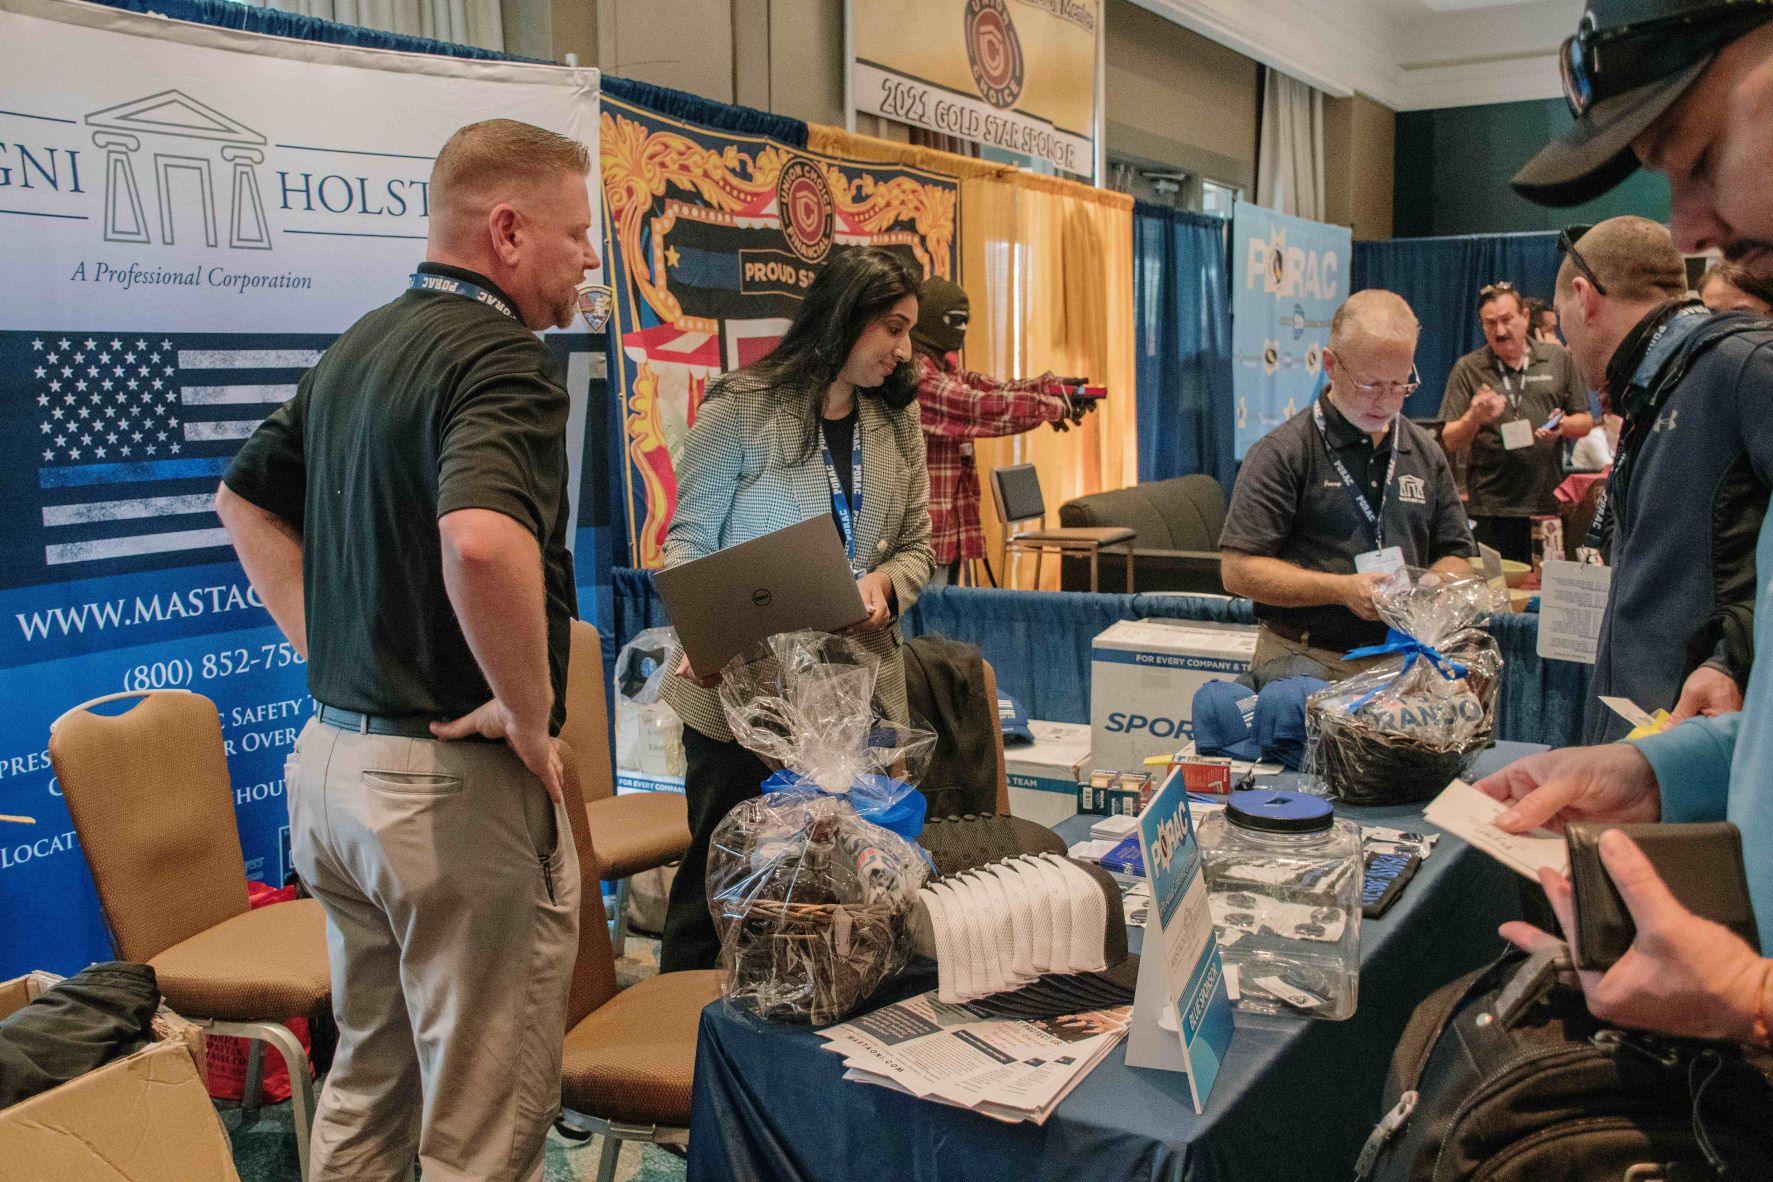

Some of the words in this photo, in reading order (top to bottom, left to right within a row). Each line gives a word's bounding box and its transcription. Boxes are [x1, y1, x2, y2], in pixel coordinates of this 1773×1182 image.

[880, 78, 932, 127] 2021
[935, 99, 980, 137] GOLD
[984, 114, 1020, 150] STAR
[781, 164, 803, 203] UNION
[803, 165, 831, 213] CHOICE
[786, 225, 829, 258] FINANCIAL
[70, 263, 87, 282] A
[94, 263, 201, 290] Professional
[208, 269, 312, 293] Corporation
[422, 276, 459, 293] PORAC
[745, 262, 797, 284] PROUD
[826, 464, 842, 495] PORAC
[853, 464, 862, 495] PORAC
[839, 508, 852, 541] PORAC
[124, 659, 193, 691] (800)
[1136, 654, 1154, 663] FOR
[1156, 656, 1184, 665] EVERY
[1187, 659, 1230, 670] COMPANY
[232, 699, 302, 728] SAFETY
[242, 727, 297, 753] OVER
[619, 778, 632, 786] FOR
[633, 780, 654, 789] EVERY
[1012, 777, 1037, 787] TEAM
[1150, 800, 1188, 880] PORAC
